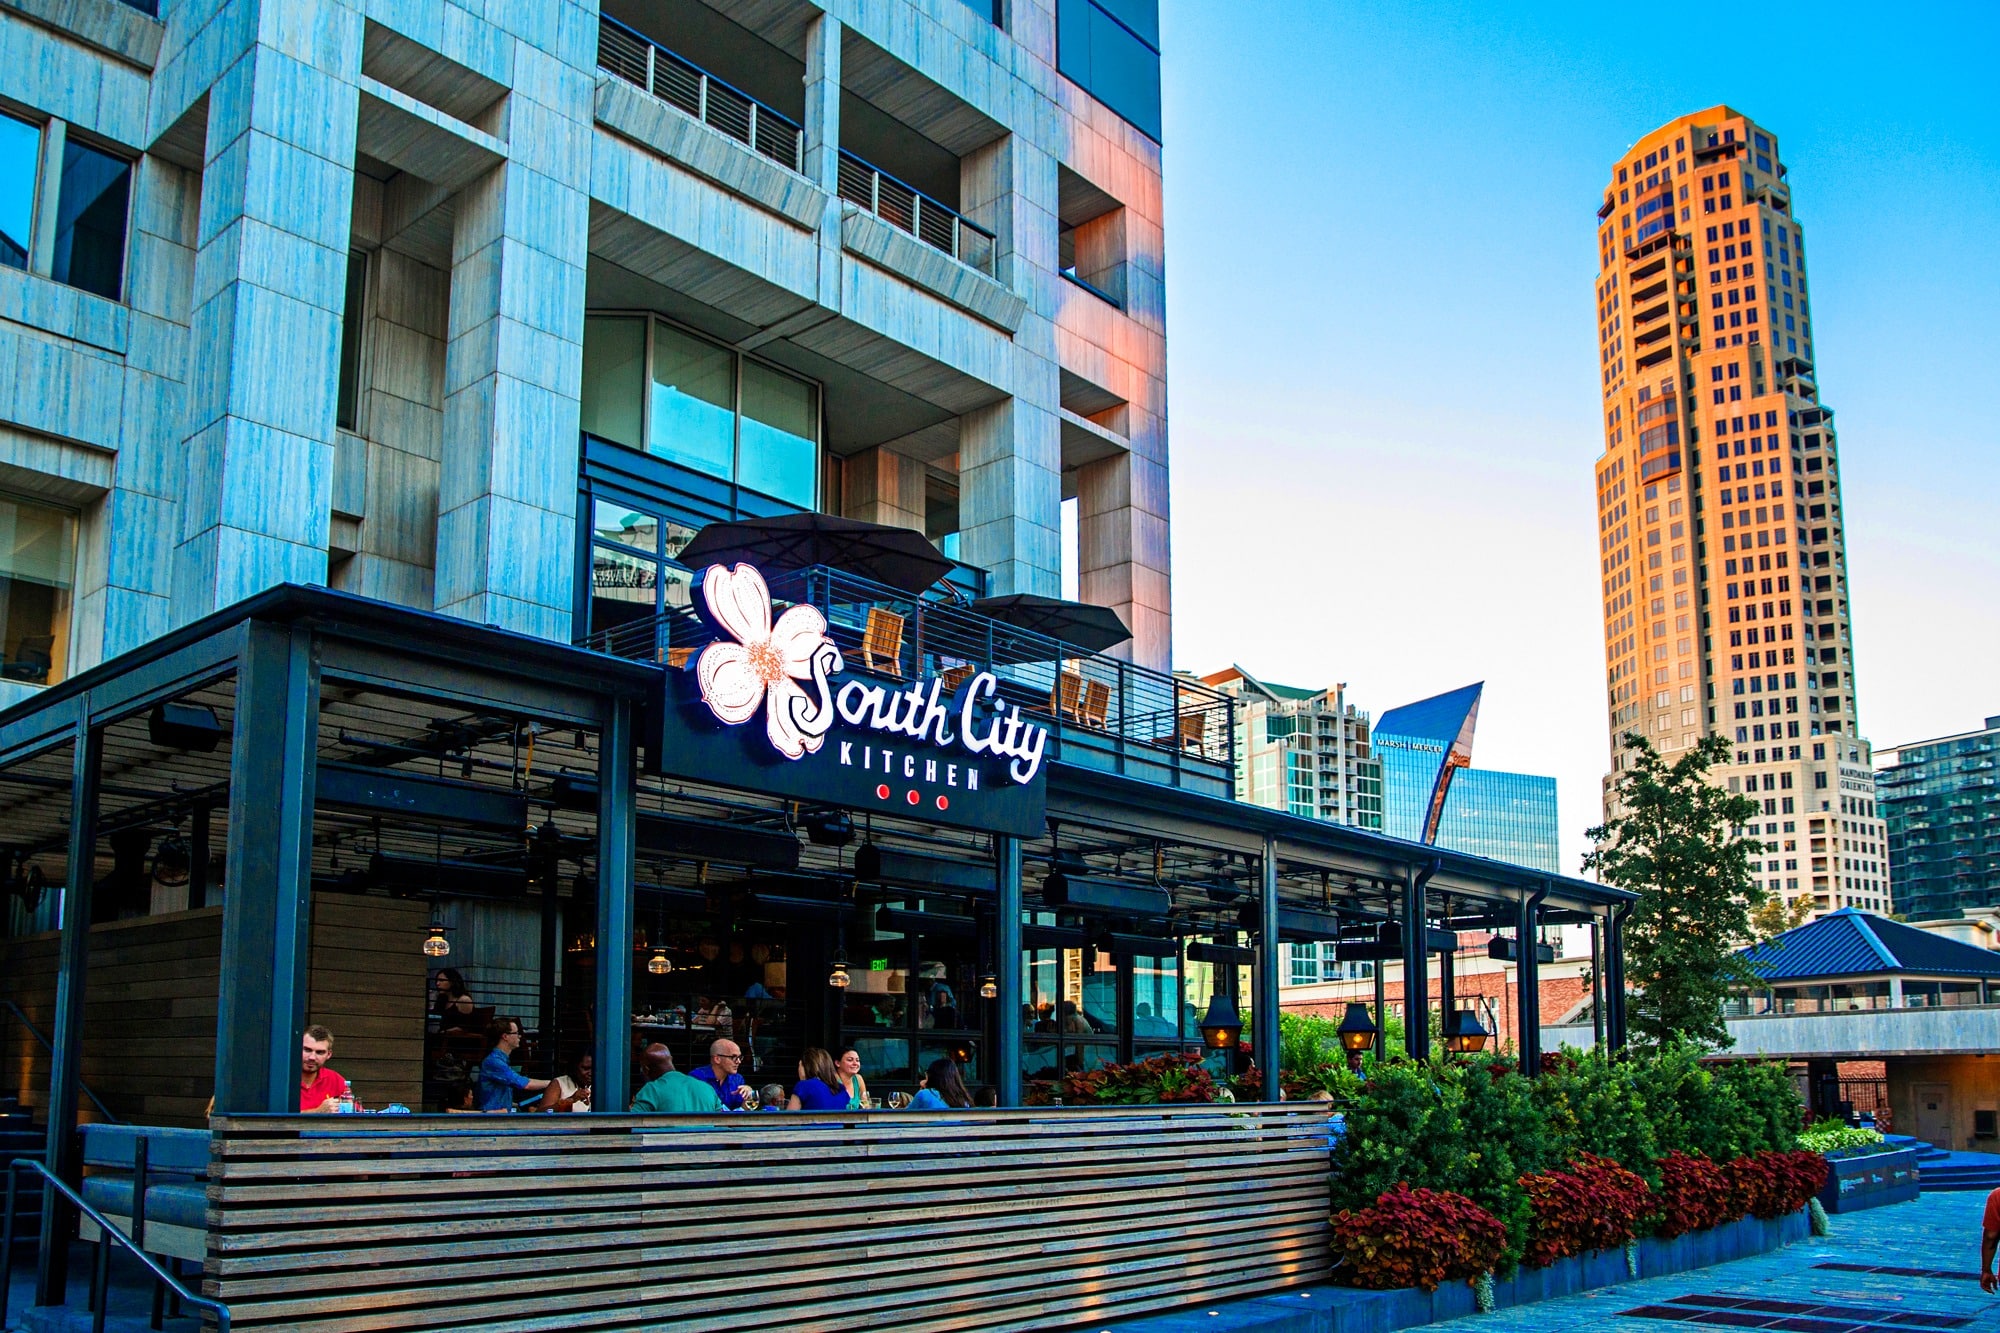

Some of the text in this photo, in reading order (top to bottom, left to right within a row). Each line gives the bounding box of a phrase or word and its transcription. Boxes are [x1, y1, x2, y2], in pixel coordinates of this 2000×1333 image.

[789, 642, 1048, 785] South City
[840, 741, 979, 791] KITCHEN
[1377, 738, 1443, 753] MARSH MERCER
